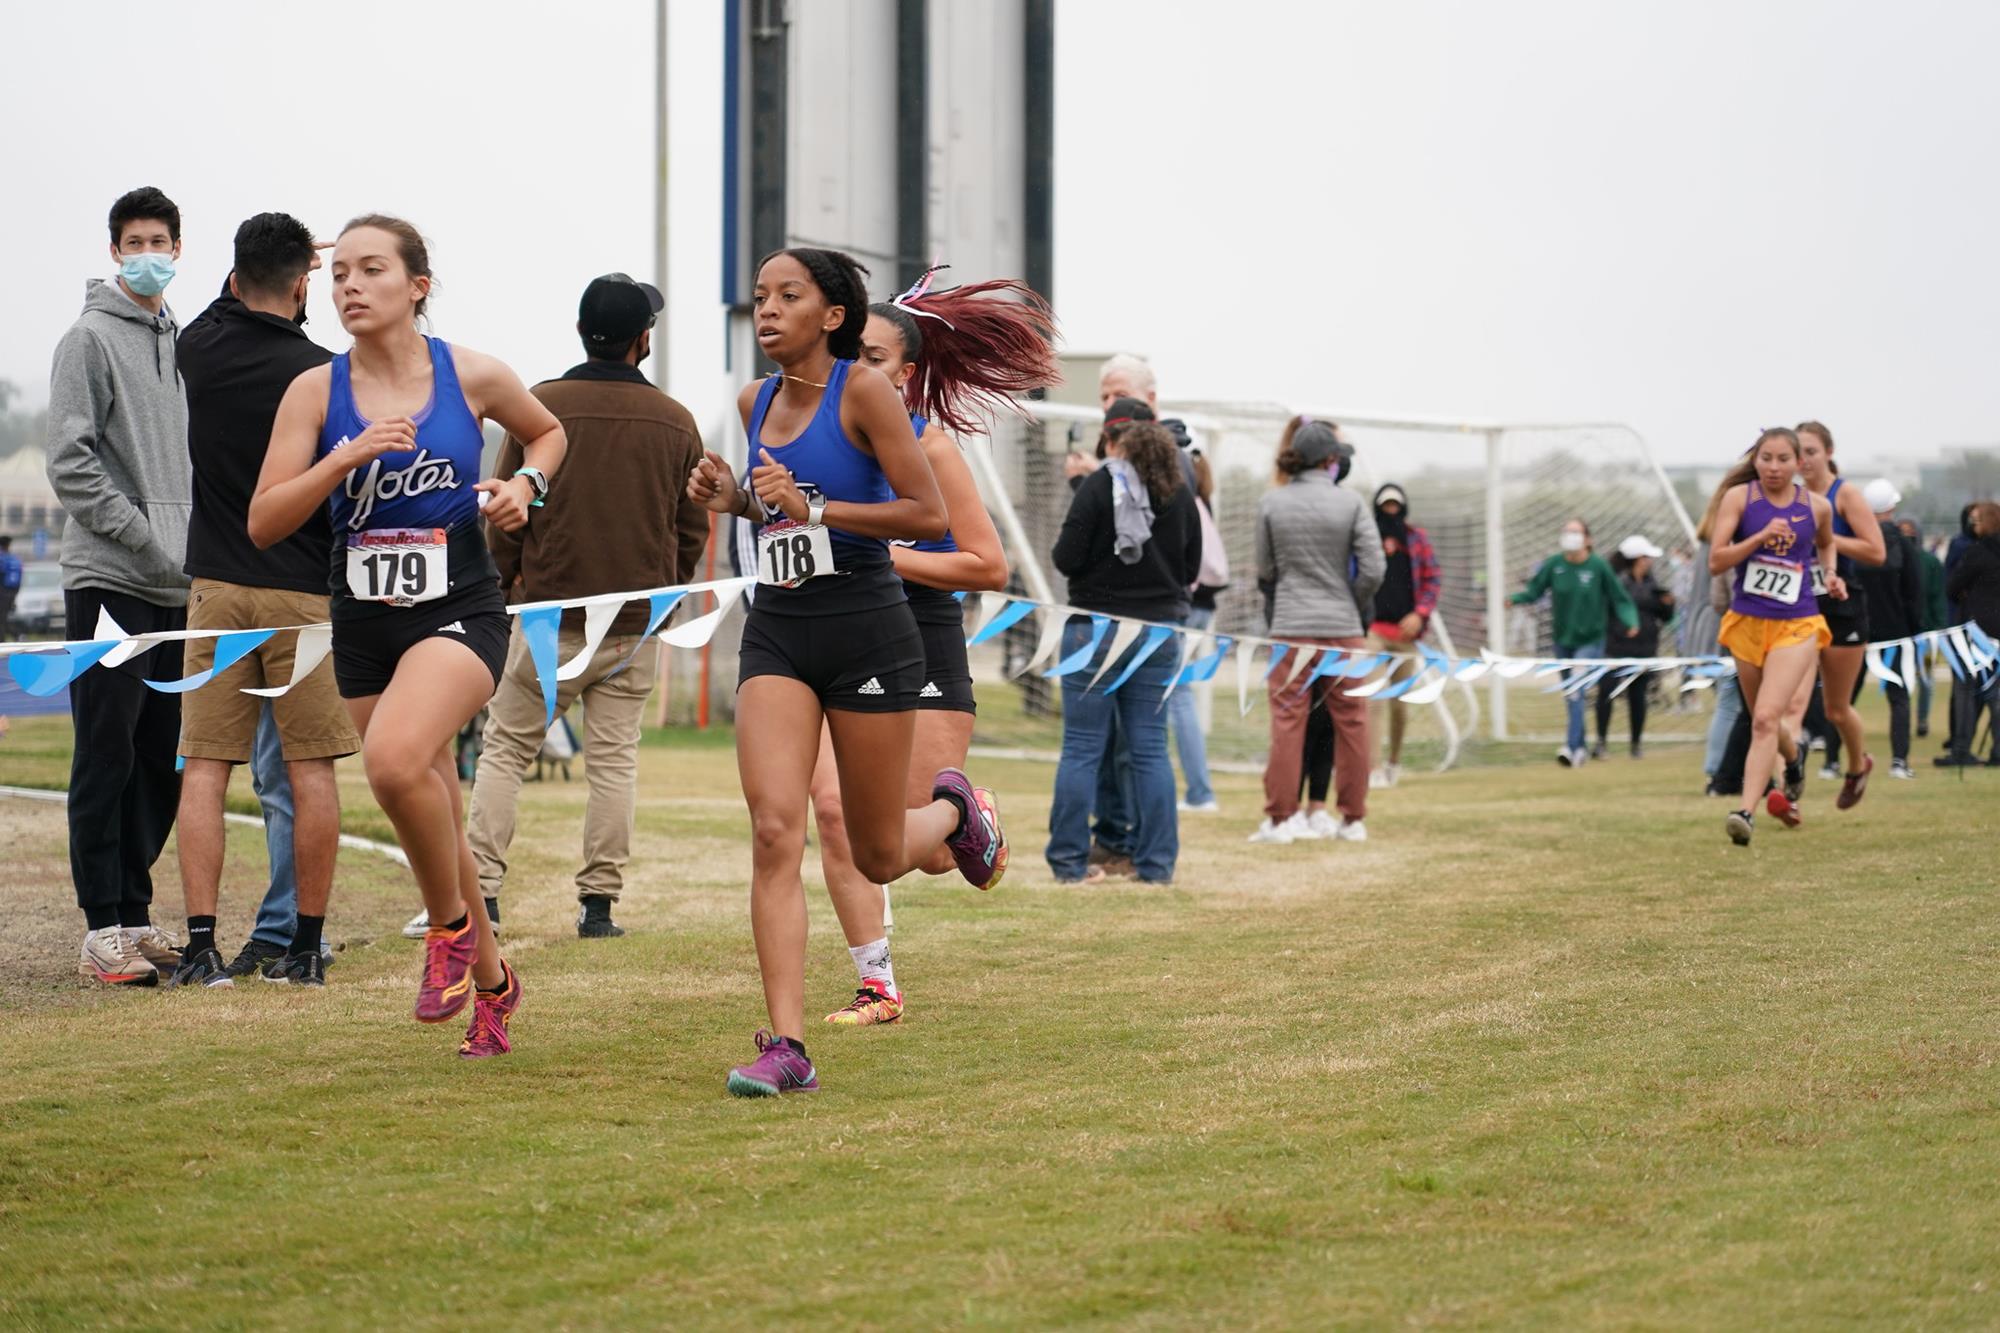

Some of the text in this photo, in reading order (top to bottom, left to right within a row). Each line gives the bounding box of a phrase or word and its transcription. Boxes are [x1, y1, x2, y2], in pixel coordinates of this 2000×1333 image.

[362, 552, 427, 597] 179
[766, 534, 816, 583] 178
[1754, 568, 1792, 596] 272
[857, 687, 885, 695] adidas
